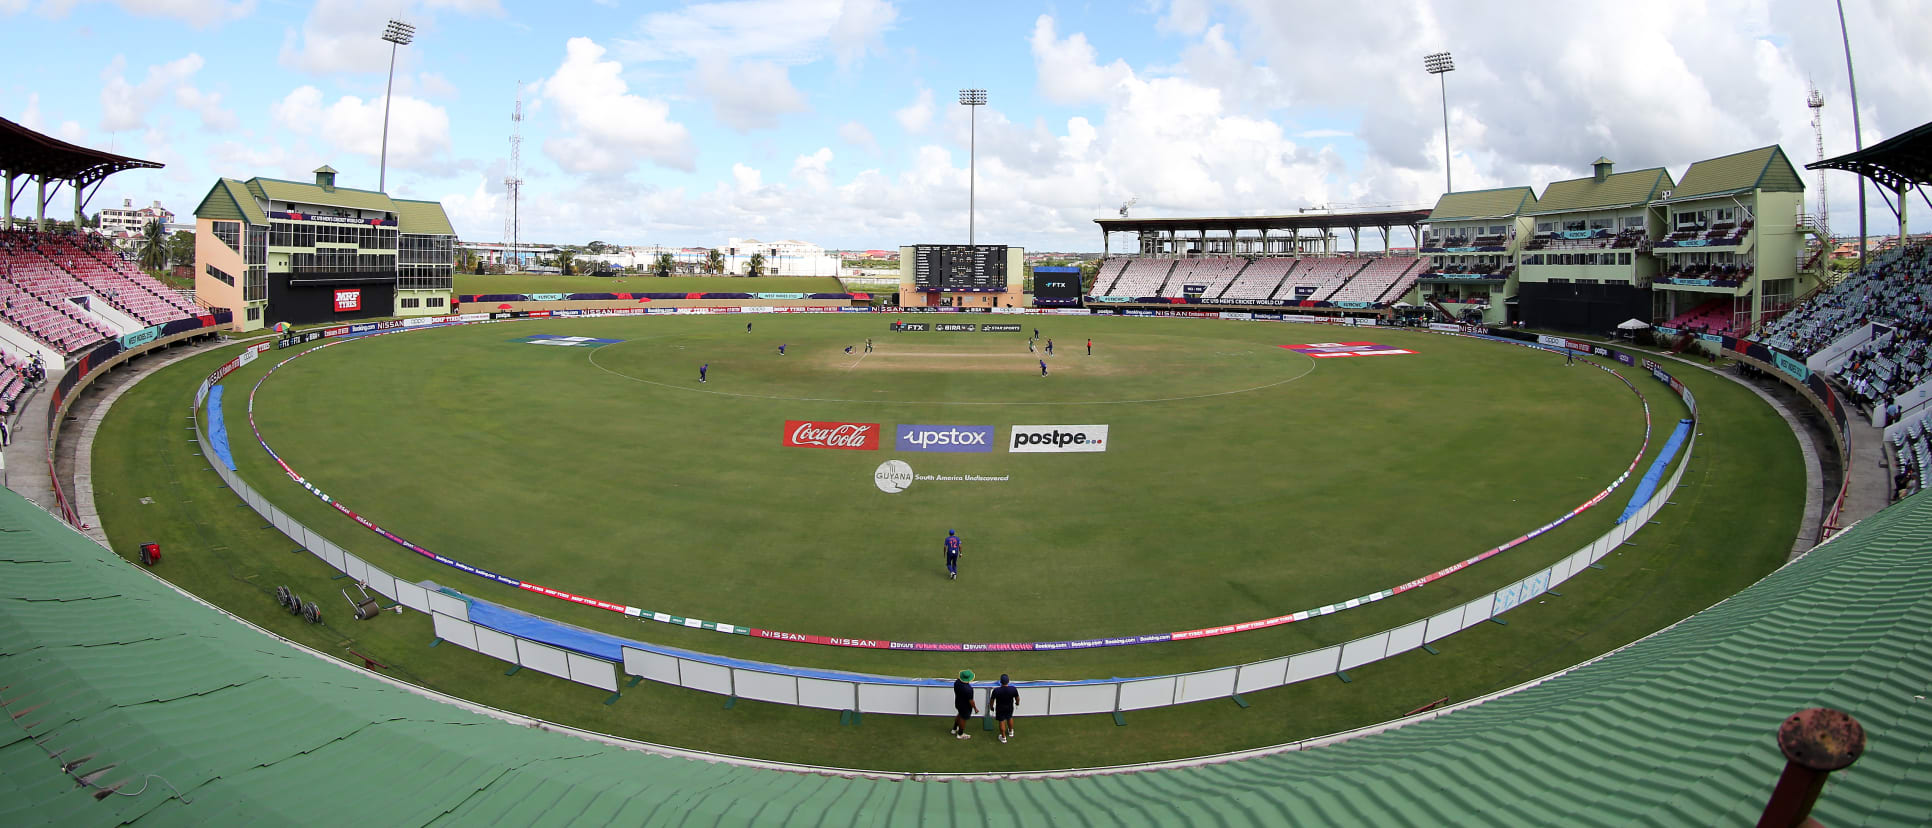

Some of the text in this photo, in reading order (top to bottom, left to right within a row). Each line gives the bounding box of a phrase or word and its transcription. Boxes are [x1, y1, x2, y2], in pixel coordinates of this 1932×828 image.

[336, 292, 360, 302] MRF
[378, 320, 404, 330] NISSAN
[1460, 324, 1489, 334] NISSAN
[792, 422, 871, 447] Coca-Cola
[903, 427, 986, 449] upstox
[1014, 429, 1087, 449] postpe
[876, 472, 911, 481] GUYANA
[915, 473, 935, 481] South
[964, 474, 1009, 482] Undiscovered
[335, 502, 350, 514] NISSAN
[356, 515, 373, 527] NISSAN
[761, 630, 806, 641] NISSAN
[1139, 634, 1171, 642] Booking.com
[830, 638, 876, 647] NISSAN
[1105, 637, 1136, 645] Booking.com
